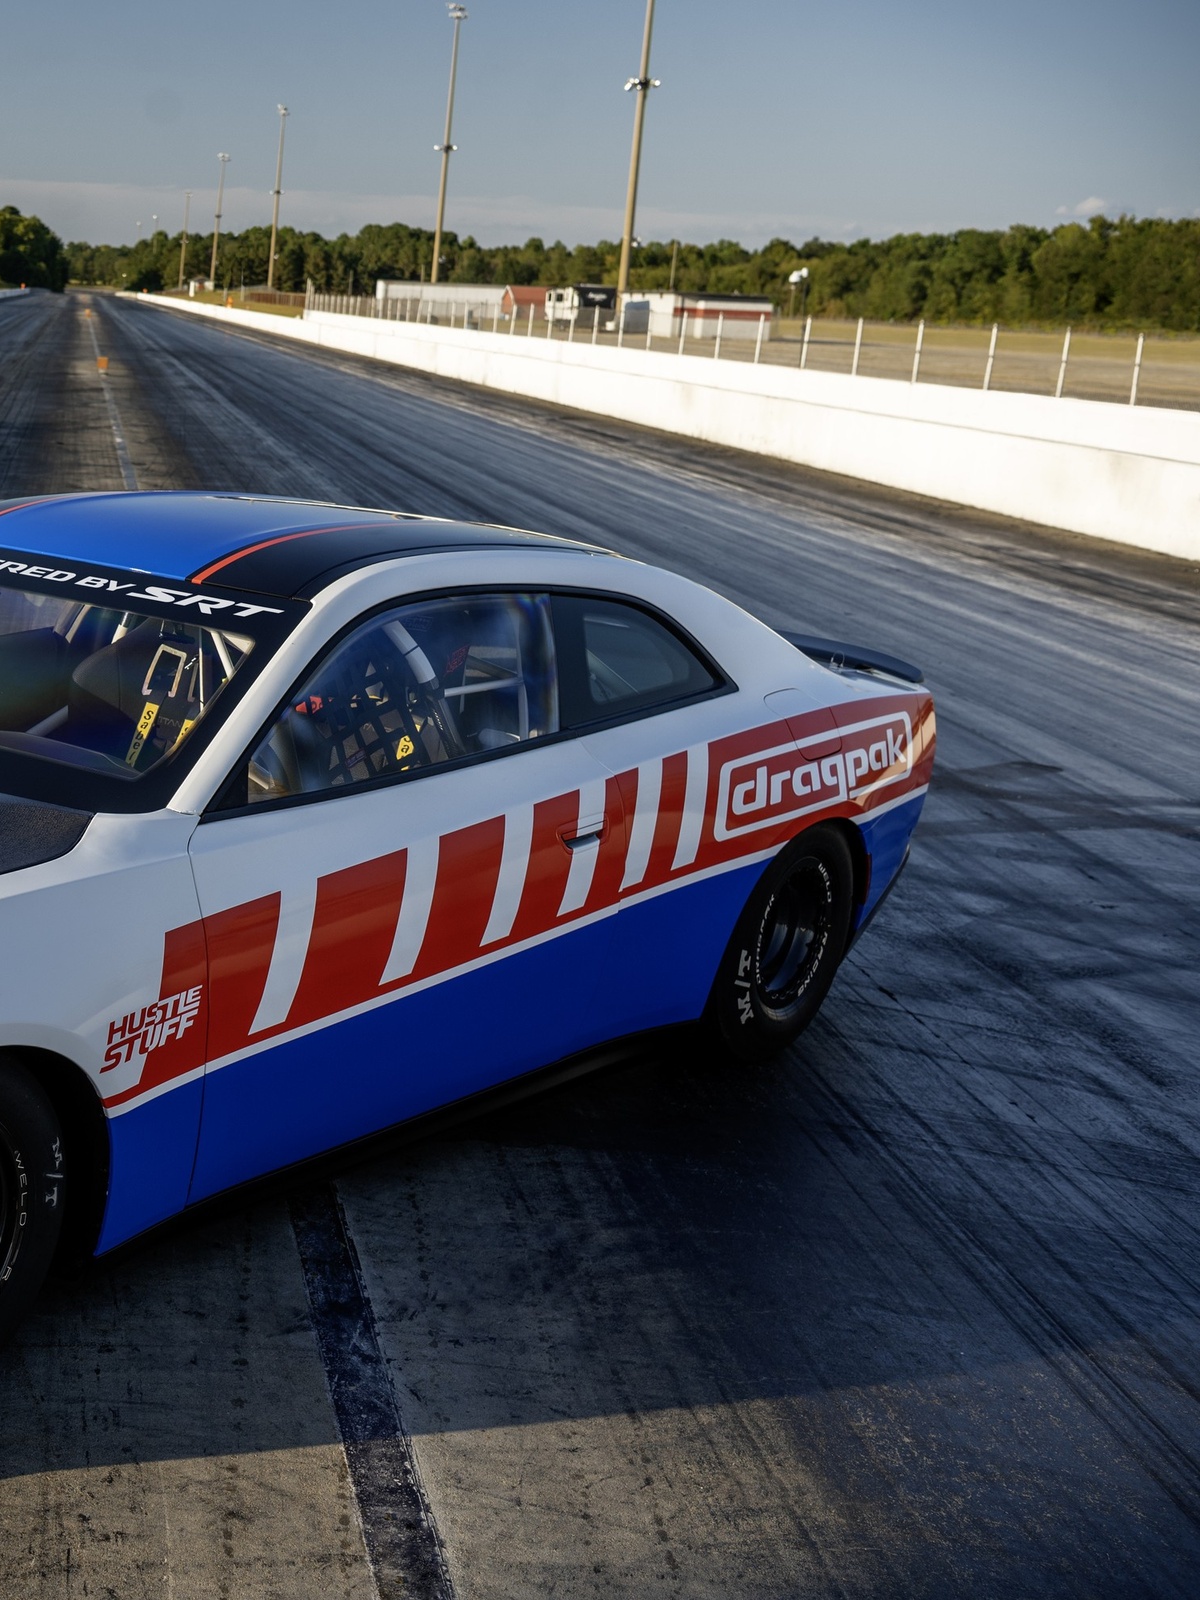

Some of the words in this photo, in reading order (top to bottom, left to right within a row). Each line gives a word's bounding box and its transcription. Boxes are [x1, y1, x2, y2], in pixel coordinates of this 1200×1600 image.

[75, 576, 136, 592] BY
[126, 585, 286, 618] SRT
[127, 709, 155, 766] Sabel
[732, 728, 907, 816] dragpak
[106, 985, 203, 1046] HUSTLE
[734, 949, 755, 1025] M/T
[99, 1008, 199, 1074] STUFF
[15, 1152, 27, 1228] WELD
